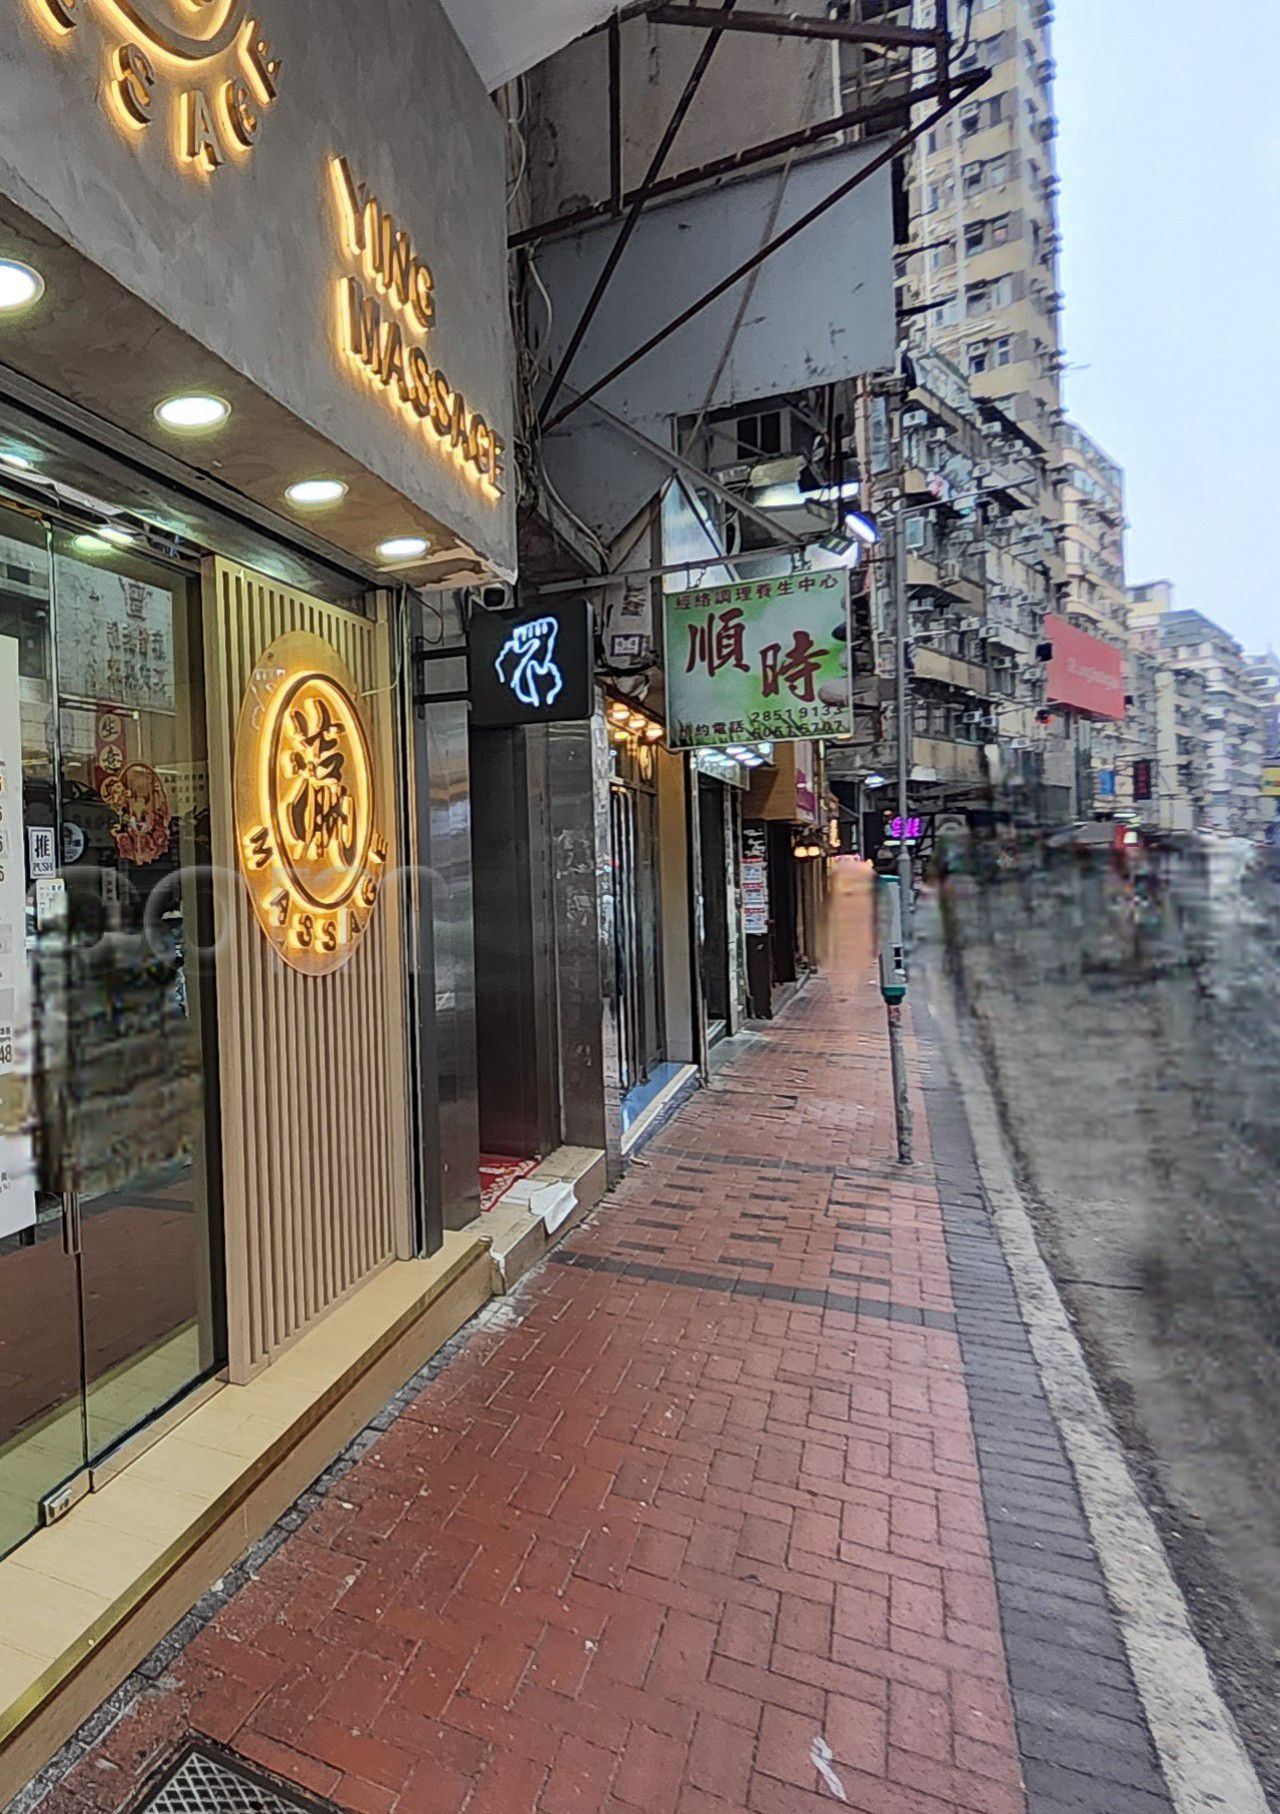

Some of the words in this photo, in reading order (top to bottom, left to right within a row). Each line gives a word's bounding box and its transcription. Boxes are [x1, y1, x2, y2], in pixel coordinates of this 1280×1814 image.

[332, 155, 436, 332] YING
[338, 275, 506, 497] MASSAGE
[685, 606, 830, 702] 順時
[33, 862, 53, 873] PUSH
[34, 834, 51, 859] 推
[243, 824, 389, 954] MASSAGE
